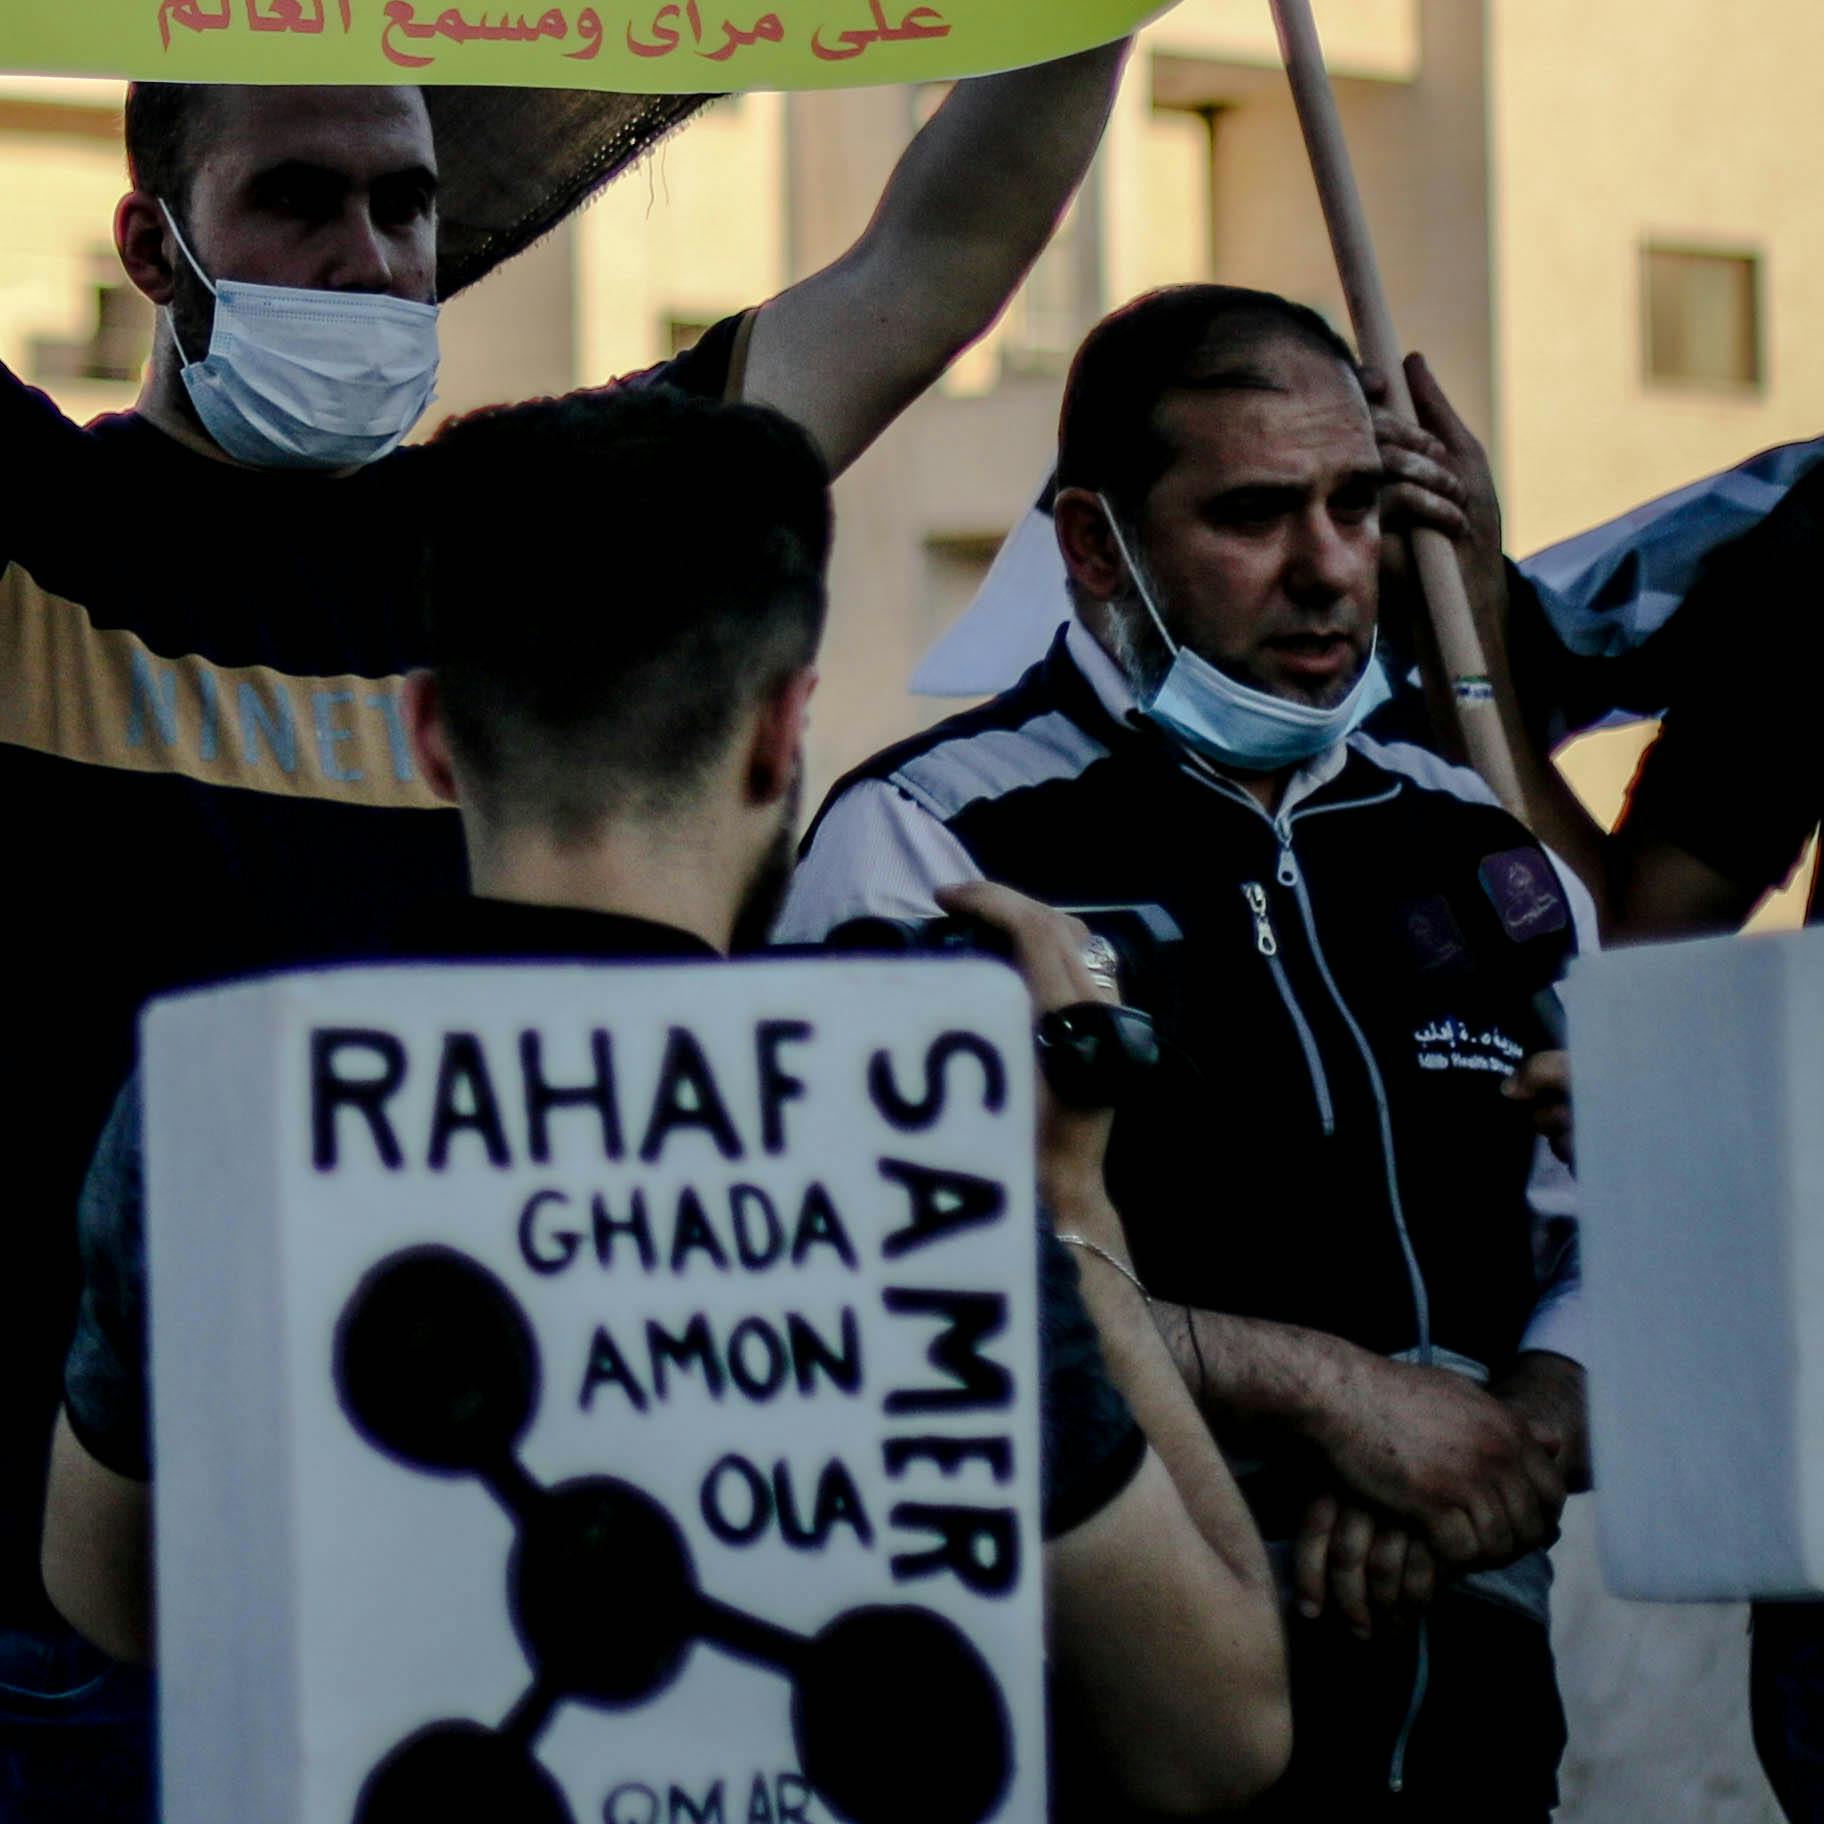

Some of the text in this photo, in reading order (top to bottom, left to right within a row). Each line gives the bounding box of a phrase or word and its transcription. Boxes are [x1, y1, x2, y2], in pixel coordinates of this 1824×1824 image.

[382, 0, 604, 68] ومسمع
[310, 1020, 812, 1173] RAHAF
[518, 1182, 858, 1276] GHADA
[578, 1307, 864, 1413] AMON
[866, 1031, 1020, 1600] SAMER
[699, 1453, 873, 1552] OLA
